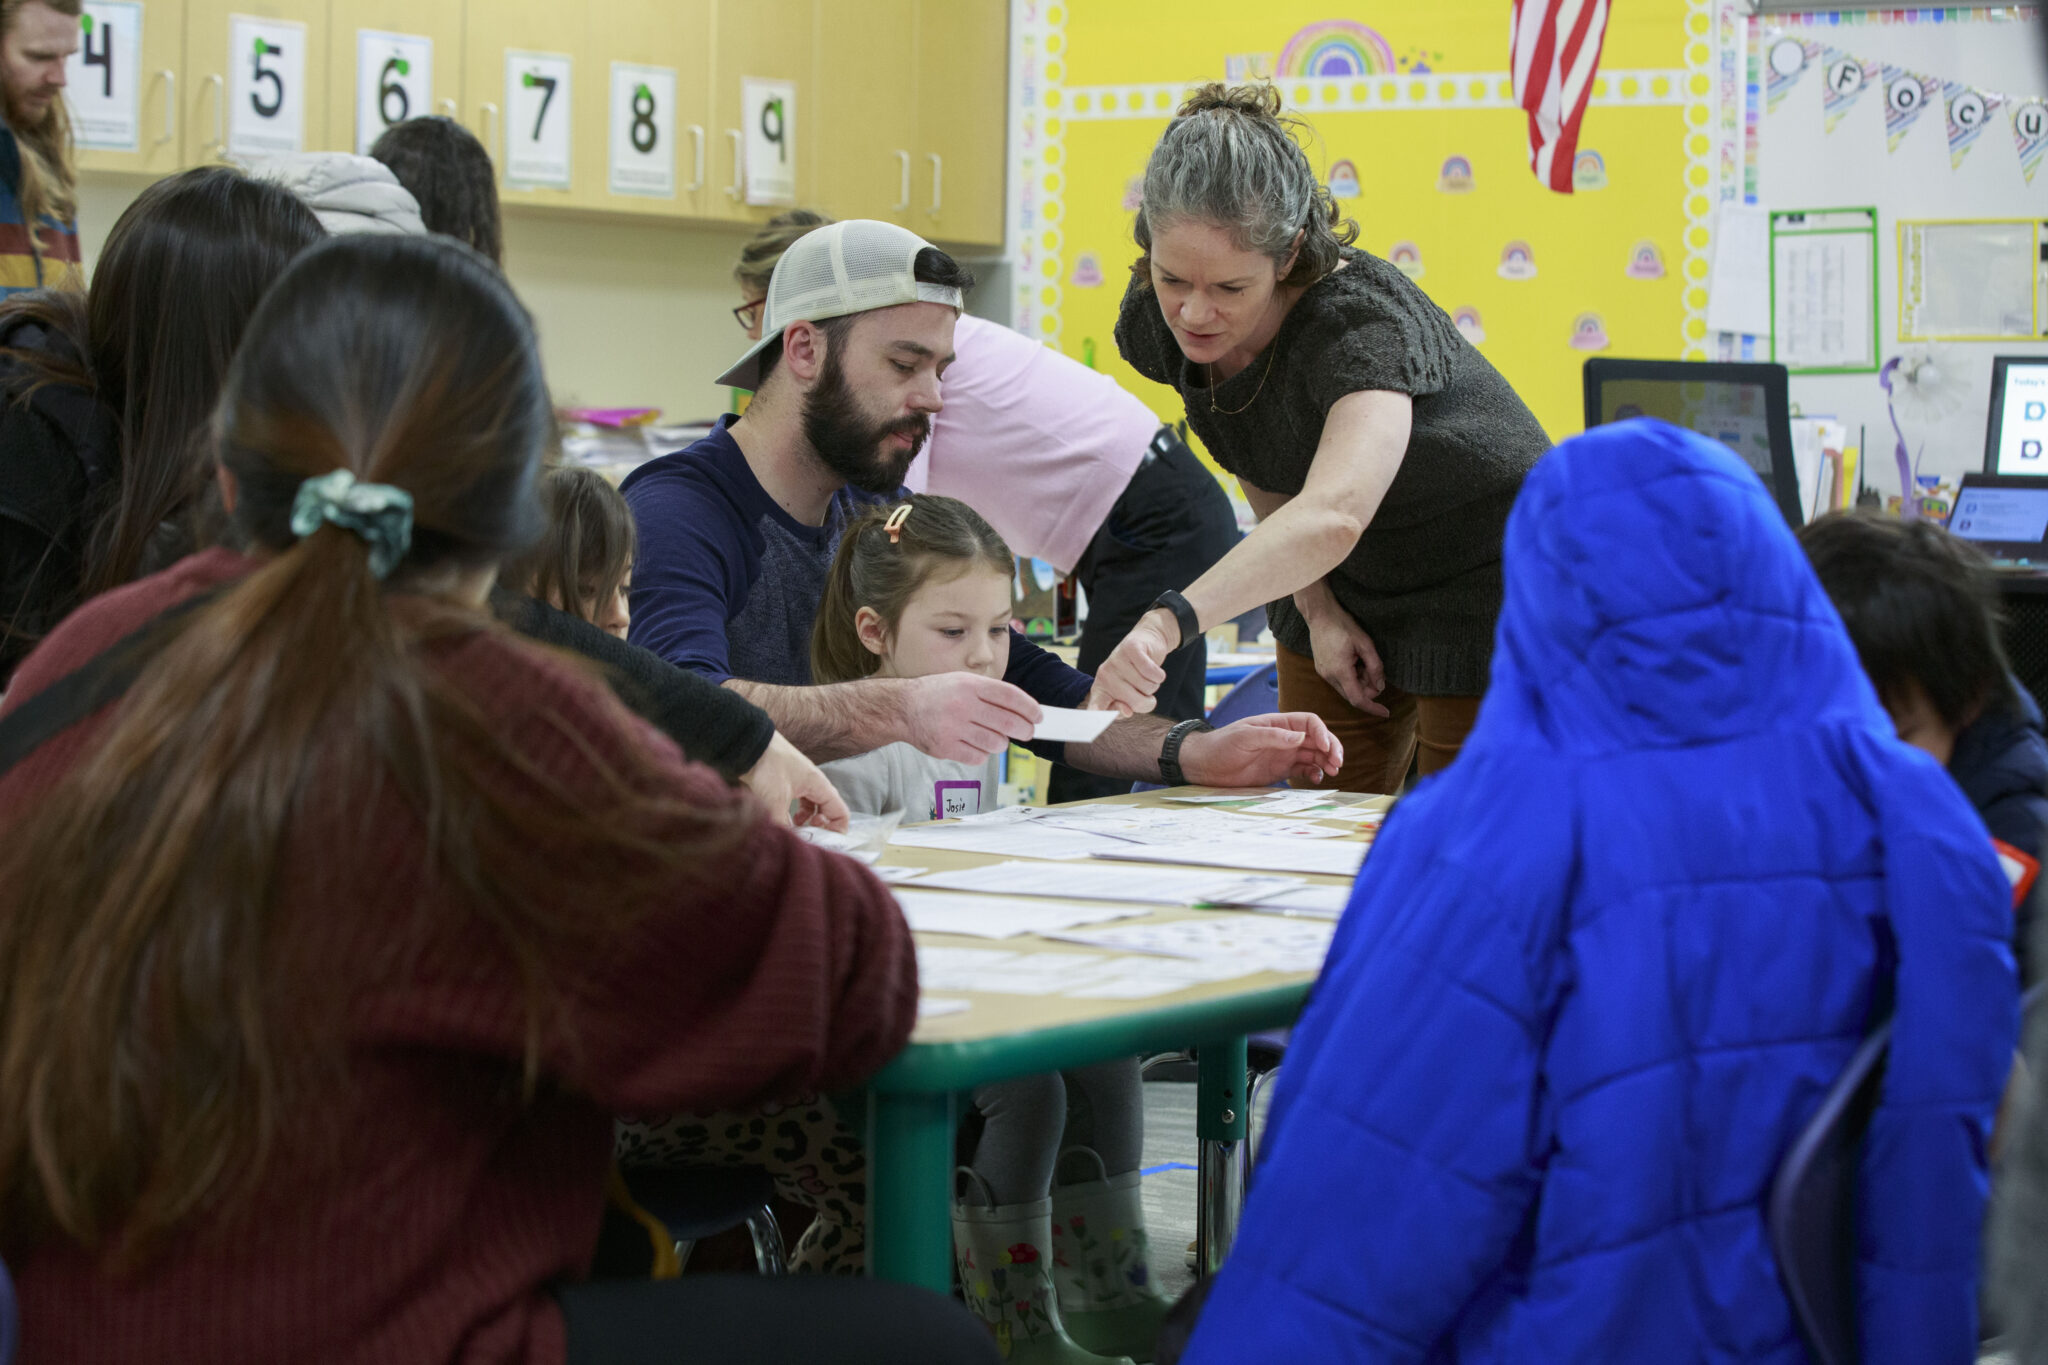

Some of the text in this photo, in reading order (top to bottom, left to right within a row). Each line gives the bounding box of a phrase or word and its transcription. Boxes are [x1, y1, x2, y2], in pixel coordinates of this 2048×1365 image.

[83, 22, 112, 97] 4
[251, 41, 283, 118] 5
[378, 57, 409, 127] 6
[524, 75, 557, 142] 7
[630, 85, 658, 155] 8
[761, 99, 787, 163] 9
[946, 797, 966, 813] Josie
